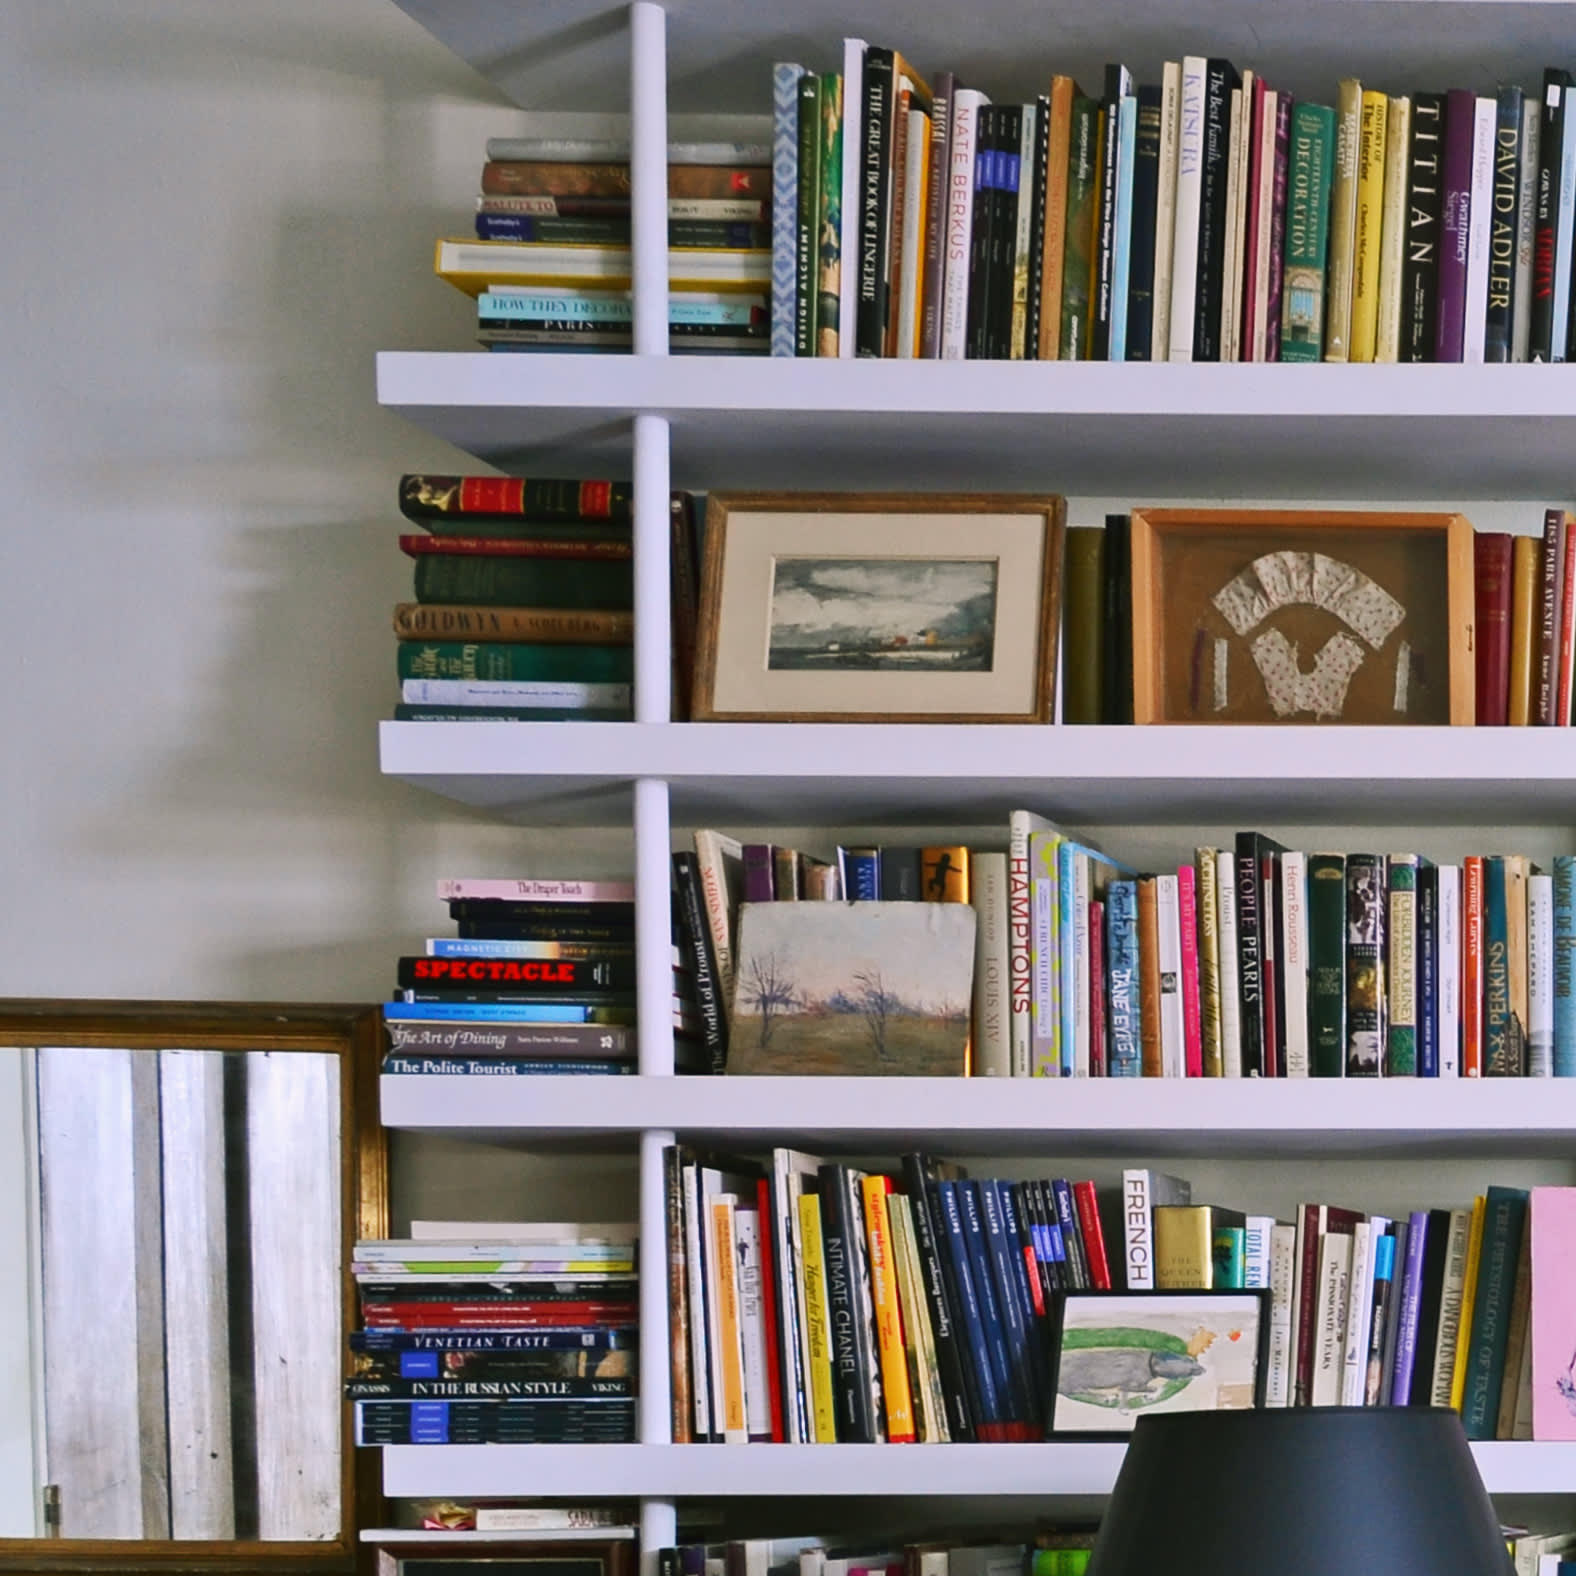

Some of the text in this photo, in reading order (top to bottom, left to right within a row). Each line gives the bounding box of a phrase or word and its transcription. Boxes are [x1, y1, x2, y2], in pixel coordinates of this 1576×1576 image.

[1181, 73, 1201, 176] KATSURA
[862, 85, 882, 301] THE GREAT BOOK OF LINGERIE
[950, 108, 969, 260] NATE BERKUS
[1292, 138, 1309, 257] DECORATION
[1309, 139, 1322, 258] EIGHTEENTH-CENTURY
[1409, 101, 1440, 264] TITIAN
[1444, 191, 1459, 232] Siegel
[1454, 192, 1469, 264] Gwathmey
[1490, 128, 1517, 308] DAVID ADLER
[493, 299, 569, 313] HOW THEY
[799, 225, 809, 349] DESIGN ALCHEMY
[1543, 519, 1556, 640] 1185 PARK AVENUE
[1011, 858, 1031, 1014] HAMPTONS
[1239, 857, 1259, 1002] PEOPLE PEARLS
[1287, 865, 1300, 963] Henri Rousseau
[1555, 915, 1570, 932] DE
[415, 960, 575, 982] SPECTACLE
[986, 958, 999, 1043] LOUIS XIV
[1111, 968, 1135, 1054] JANE EYRE
[392, 1060, 517, 1075] The Polite Tourist
[393, 1028, 507, 1049] The Art of Dining
[946, 1191, 960, 1234] PHILLIPS
[1127, 1180, 1149, 1282] FRENCH
[1246, 1228, 1262, 1259] TOTAL
[415, 1334, 550, 1348] VENETIAN TASTE
[827, 1238, 855, 1377] INTIMATE CHANEL
[412, 1382, 571, 1395] IN THE RUSSIAN STYLE
